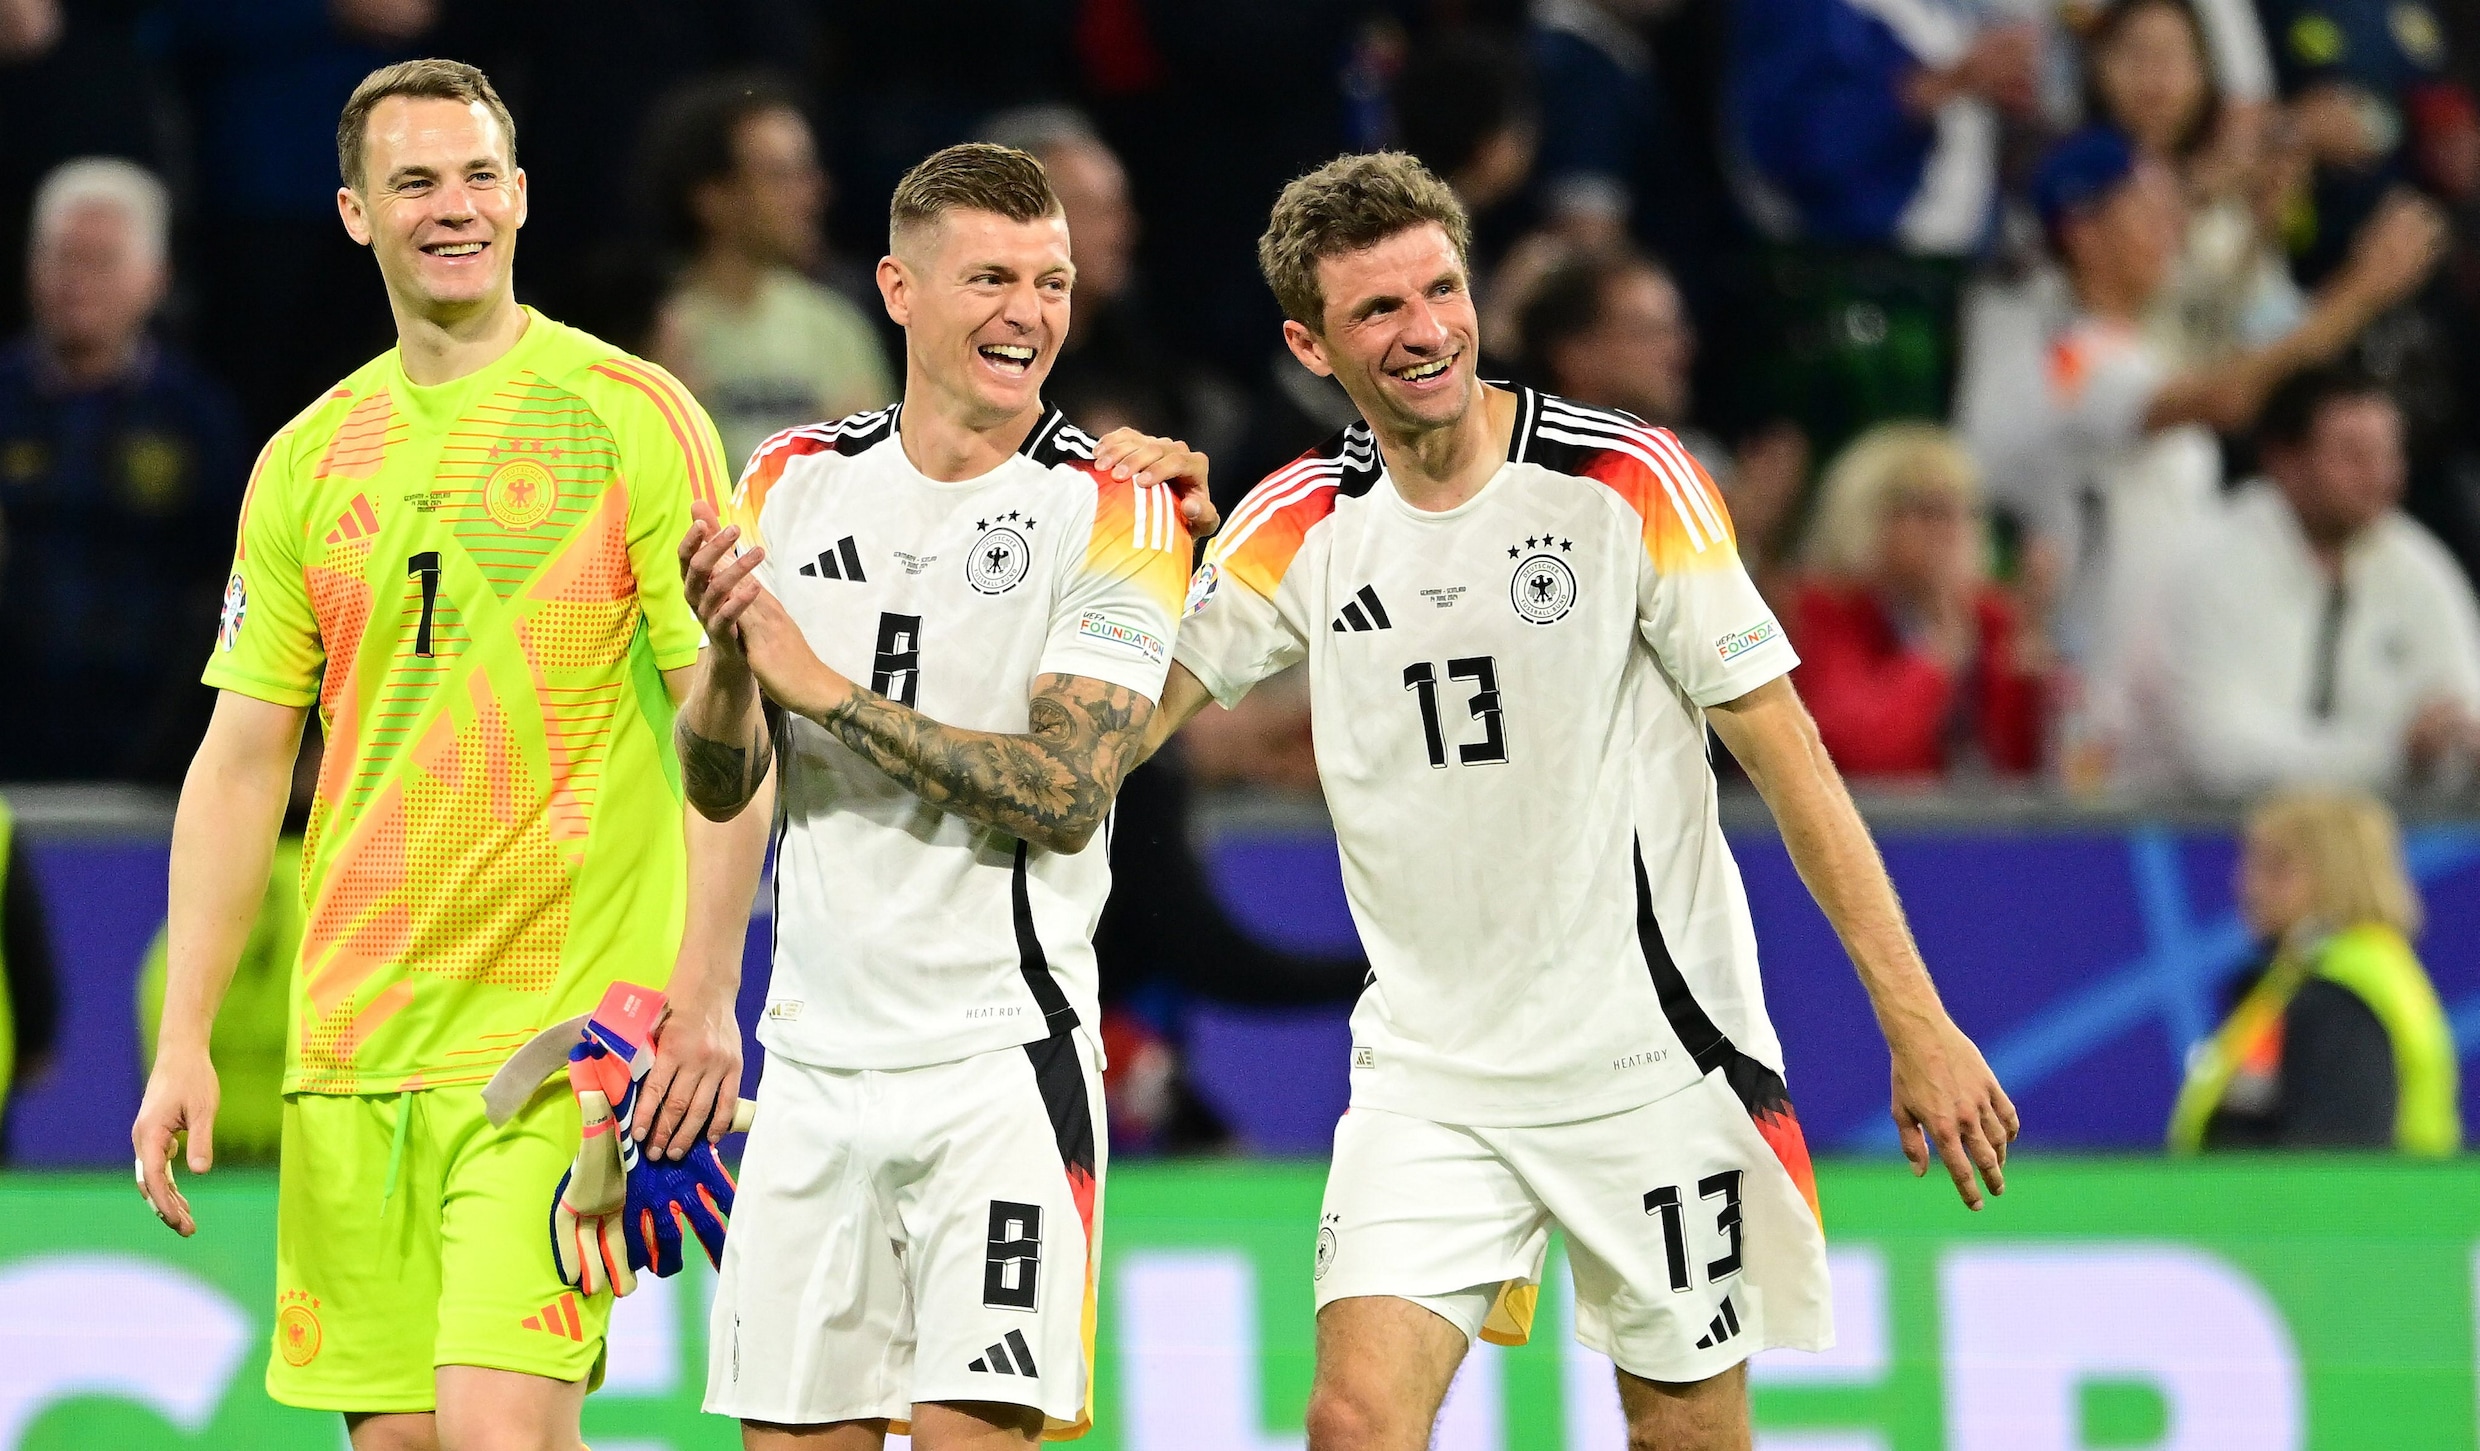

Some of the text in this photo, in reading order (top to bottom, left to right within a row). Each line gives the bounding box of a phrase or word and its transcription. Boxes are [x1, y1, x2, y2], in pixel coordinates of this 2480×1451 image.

[408, 551, 442, 658] 1
[1080, 619, 1165, 657] FOUNDATION
[1083, 611, 1106, 621] UEFA
[1715, 633, 1737, 647] UEFA
[1719, 622, 1774, 658] FOUNDA
[1403, 656, 1509, 769] 13
[983, 1199, 1044, 1313] 8
[1643, 1169, 1744, 1293] 13
